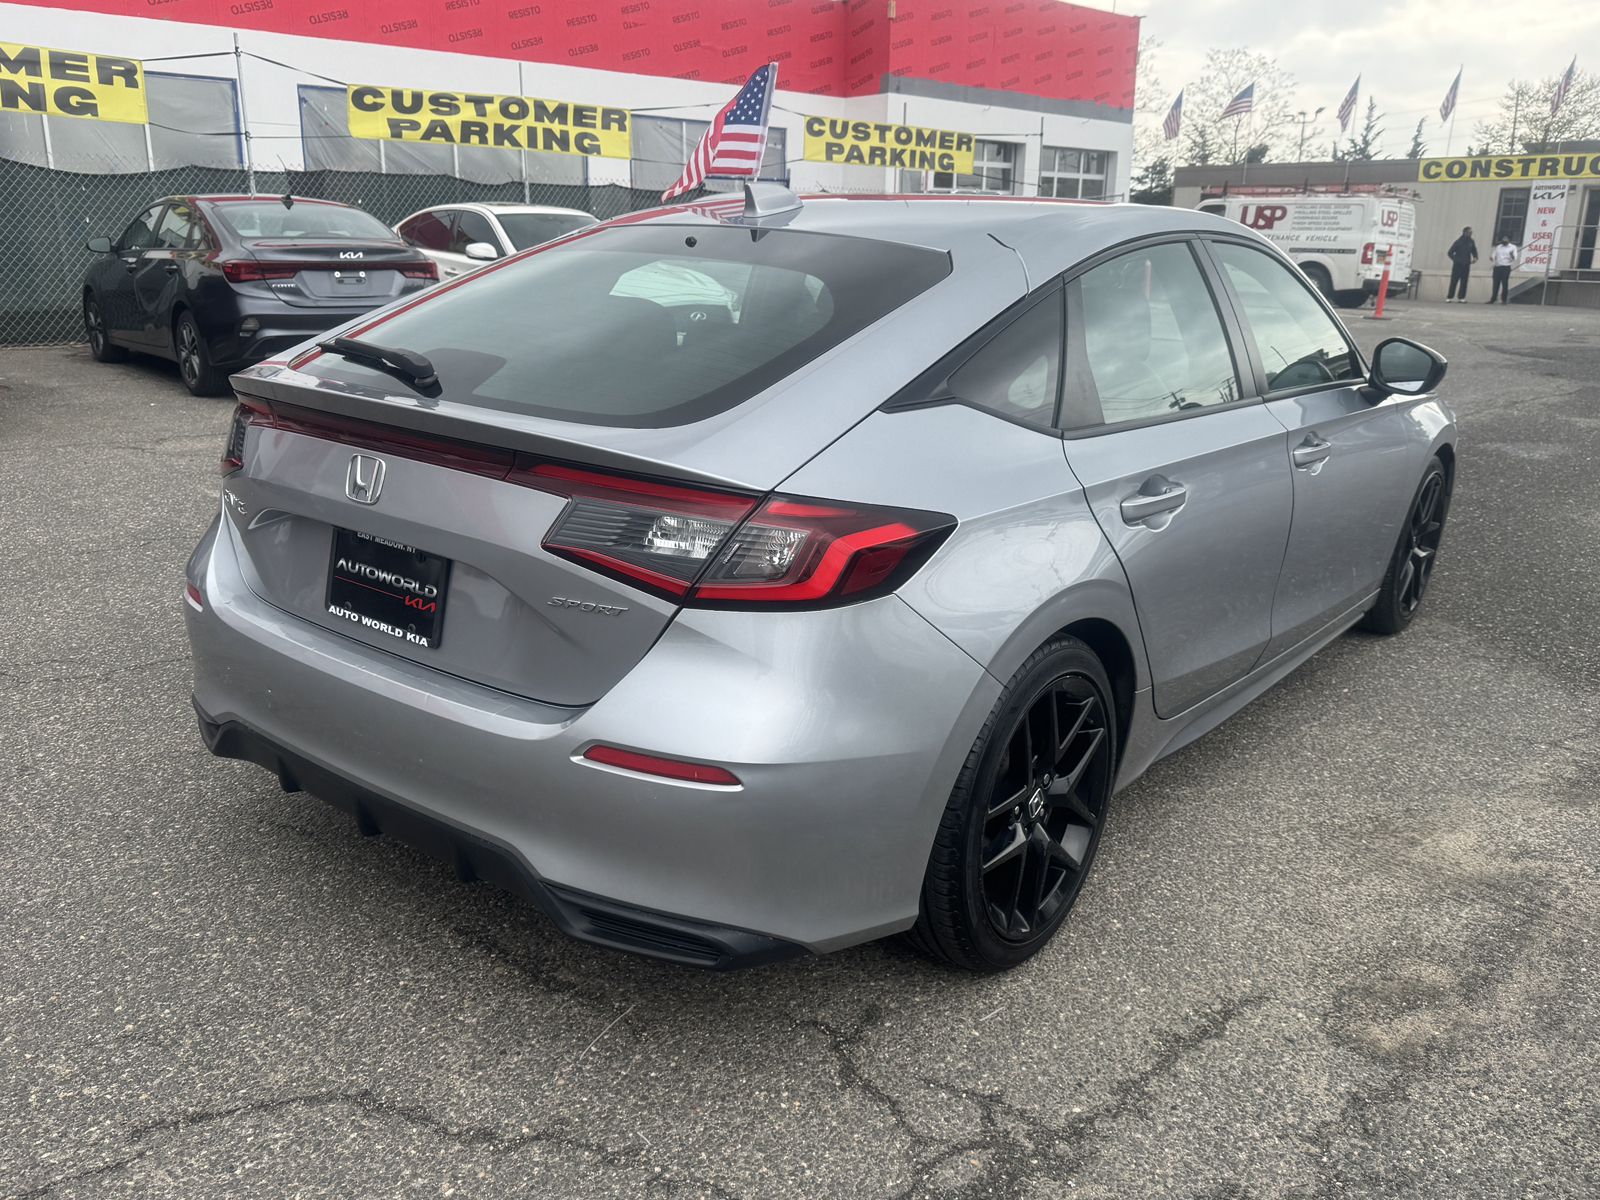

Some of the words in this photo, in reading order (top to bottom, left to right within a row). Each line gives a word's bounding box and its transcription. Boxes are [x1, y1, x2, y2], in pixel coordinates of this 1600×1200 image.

[231, 0, 274, 15] RESISTO
[508, 6, 541, 20] RESISTO
[621, 2, 650, 14] RESISTO
[811, 3, 834, 15] RESISTO
[309, 9, 349, 25] RESISTO
[566, 14, 598, 27] RESISTO
[673, 11, 700, 24] RESISTO
[381, 19, 418, 34] RESISTO
[721, 18, 747, 31] RESISTO
[767, 25, 791, 37] RESISTO
[448, 28, 483, 43] RESISTO
[810, 31, 833, 43] RESISTO
[511, 36, 543, 50] RESISTO
[674, 39, 701, 52] RESISTO
[568, 44, 599, 57] RESISTO
[622, 48, 650, 61] RESISTO
[722, 45, 748, 58] RESISTO
[810, 57, 833, 69] RESISTO
[351, 86, 627, 132] CUSTOMER
[387, 118, 601, 155] PARKING
[805, 117, 973, 152] CUSTOMER
[825, 141, 955, 171] PARKING
[1533, 191, 1565, 200] KIA
[1537, 206, 1556, 214] NEW
[1240, 205, 1287, 230] USP
[1381, 208, 1398, 227] USP
[1541, 219, 1548, 227] &
[1306, 234, 1339, 242] VEHICLE
[1532, 231, 1553, 240] USED
[1528, 243, 1553, 252] SALES
[339, 251, 363, 259] KIA
[1525, 256, 1552, 265] OFFIC
[336, 557, 438, 598] AUTOWORLD
[405, 595, 436, 612] KIA
[547, 596, 629, 616] SPORT
[328, 605, 359, 622] AUTO
[361, 616, 403, 638] WORLD
[406, 632, 429, 648] KIA
